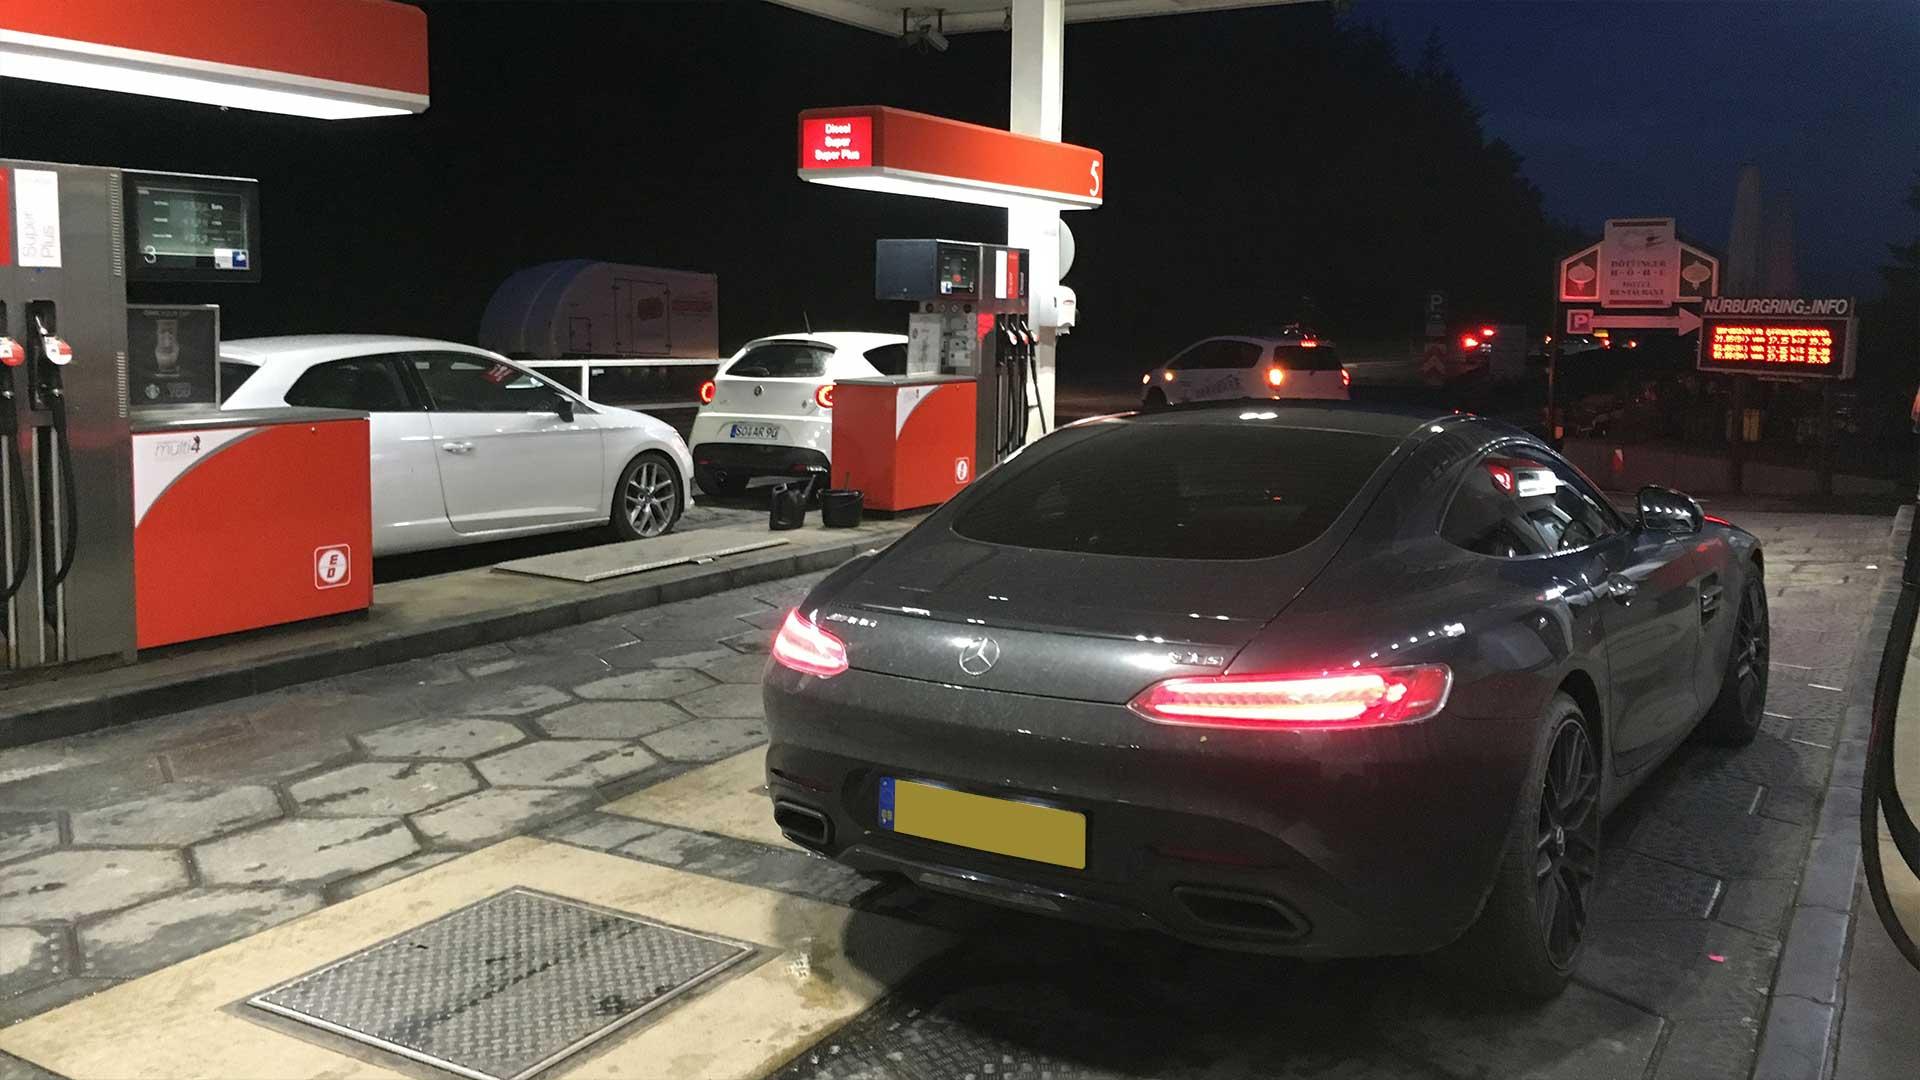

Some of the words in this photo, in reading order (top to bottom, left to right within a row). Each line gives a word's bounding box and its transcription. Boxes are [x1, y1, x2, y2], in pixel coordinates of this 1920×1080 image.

[825, 123, 851, 134] Diesel
[825, 136, 851, 148] Super
[815, 149, 840, 162] Super
[841, 149, 860, 160] Plus
[1090, 160, 1100, 197] 5
[144, 245, 156, 264] 3
[1574, 314, 1588, 328] P
